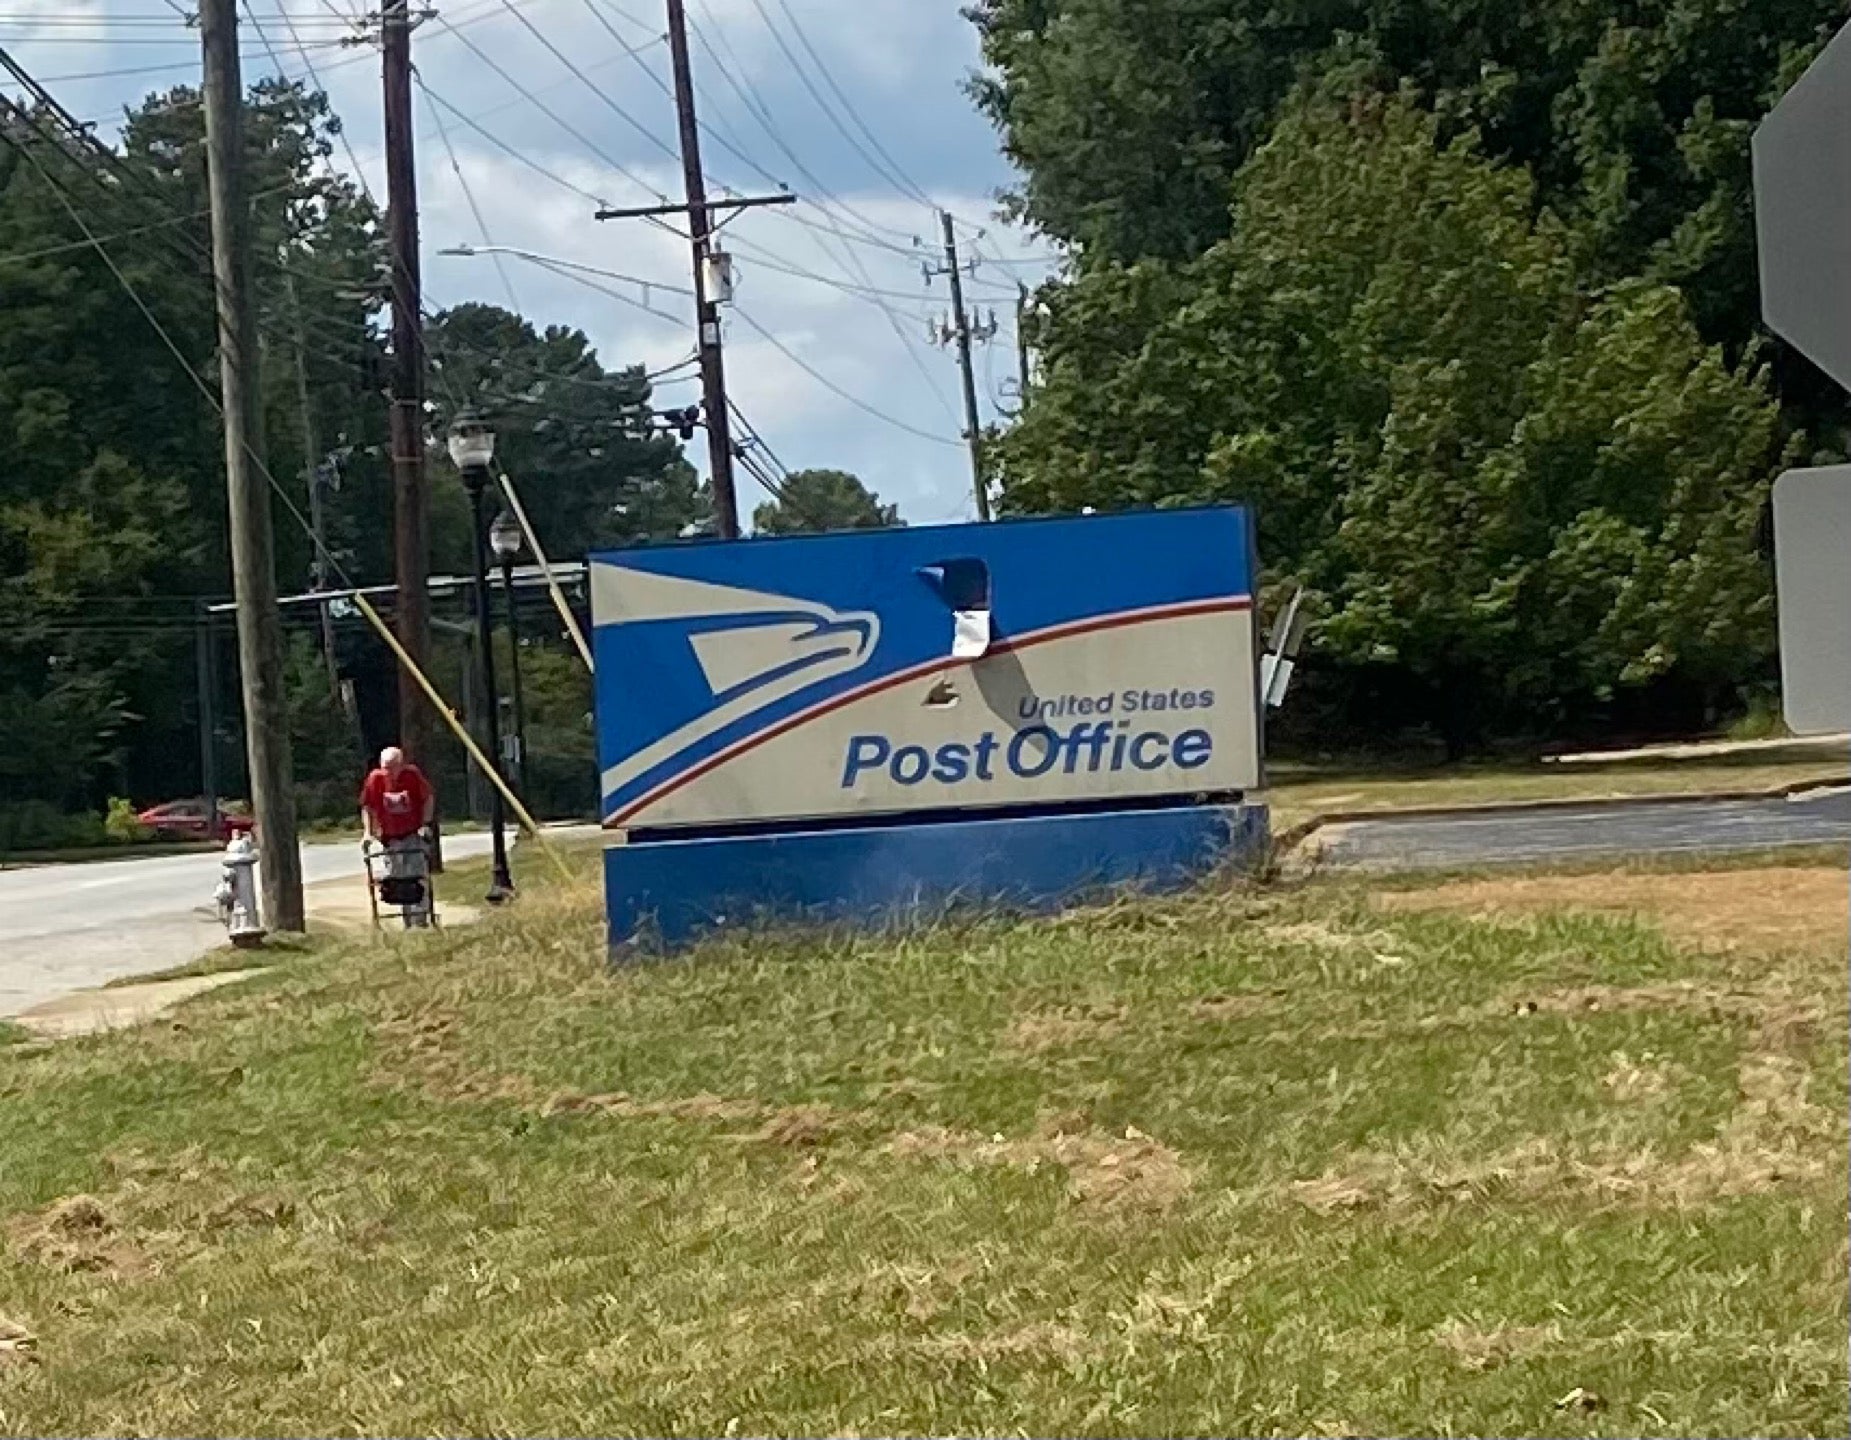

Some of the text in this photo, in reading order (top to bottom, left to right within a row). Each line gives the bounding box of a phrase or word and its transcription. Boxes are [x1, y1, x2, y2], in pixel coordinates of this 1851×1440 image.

[1019, 688, 1214, 719] United States
[841, 721, 1213, 788] Post Office
